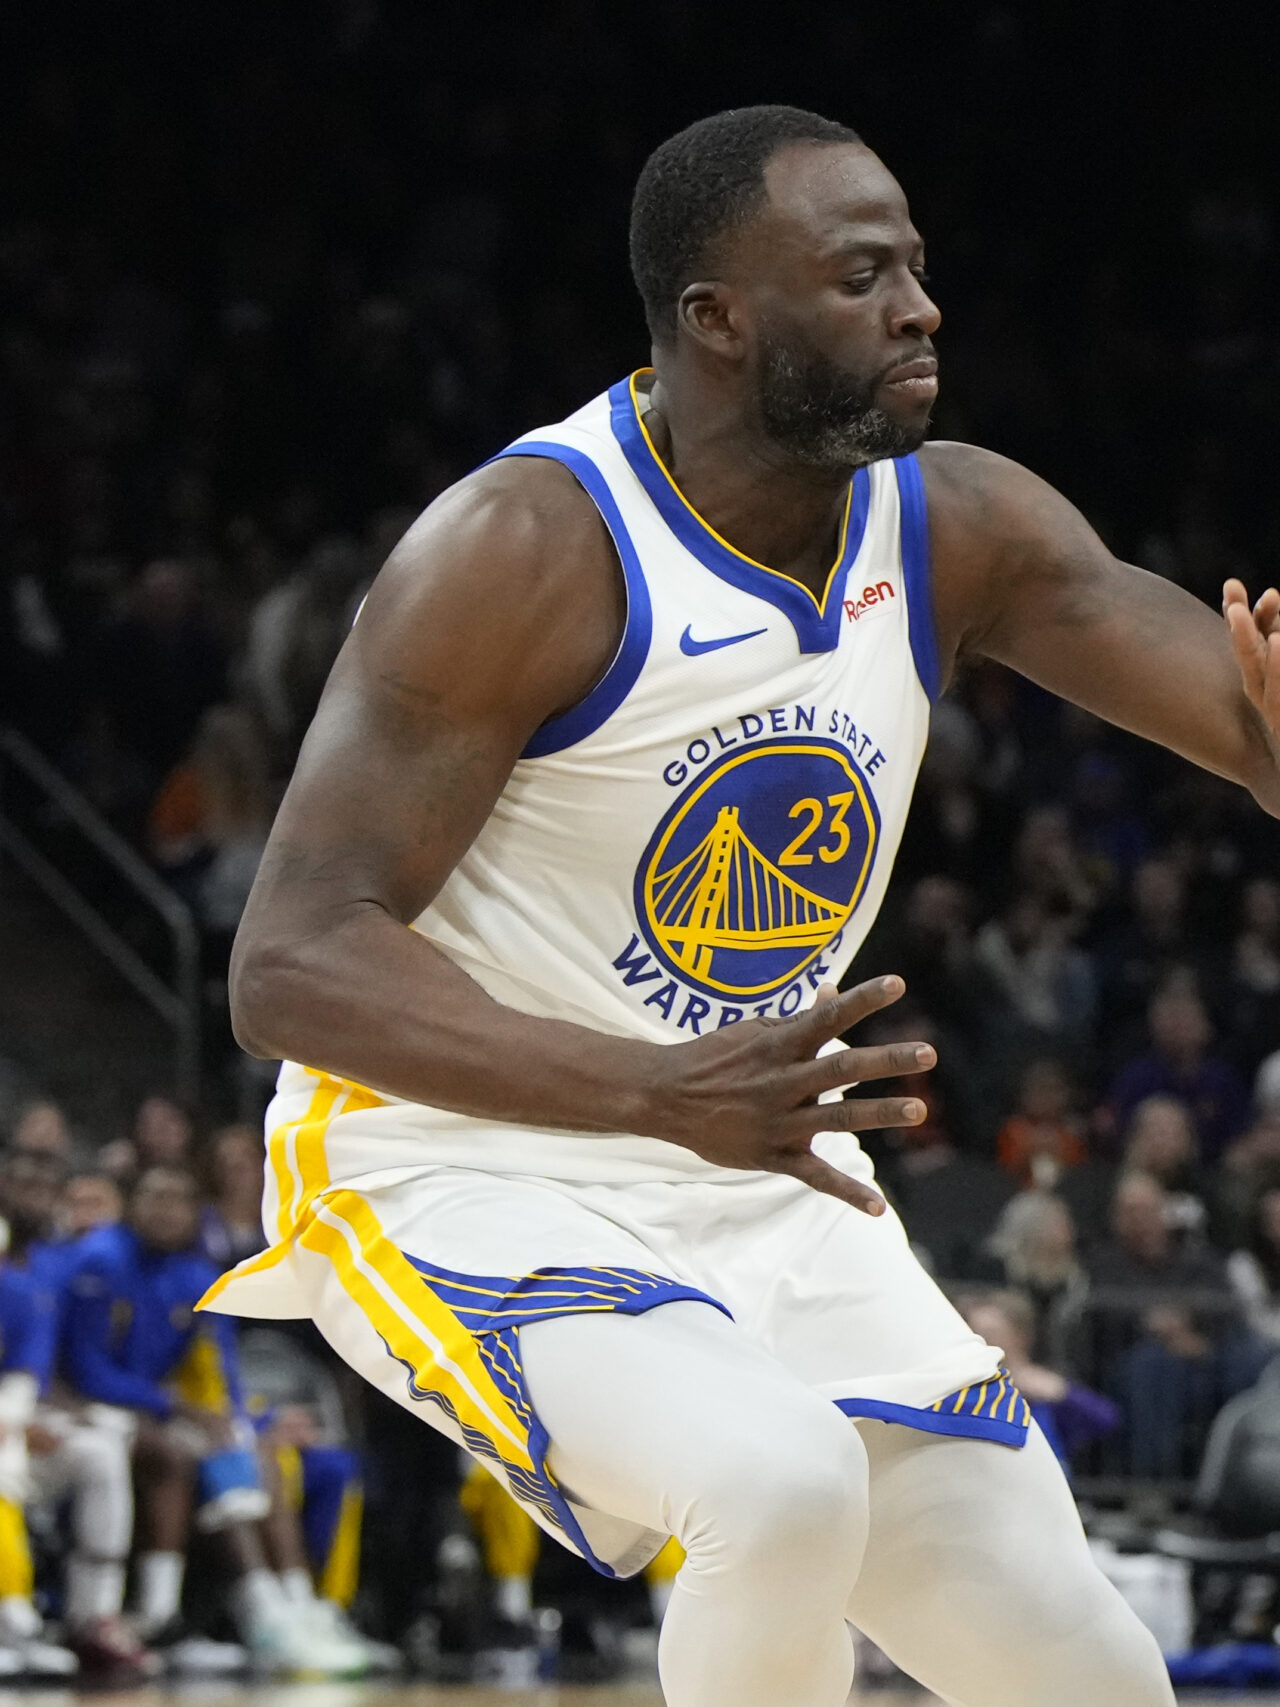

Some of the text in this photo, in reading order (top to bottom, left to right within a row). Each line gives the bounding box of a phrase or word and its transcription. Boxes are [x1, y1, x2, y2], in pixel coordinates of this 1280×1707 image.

[662, 704, 887, 787] GOLDEN STATE
[777, 790, 855, 867] 23
